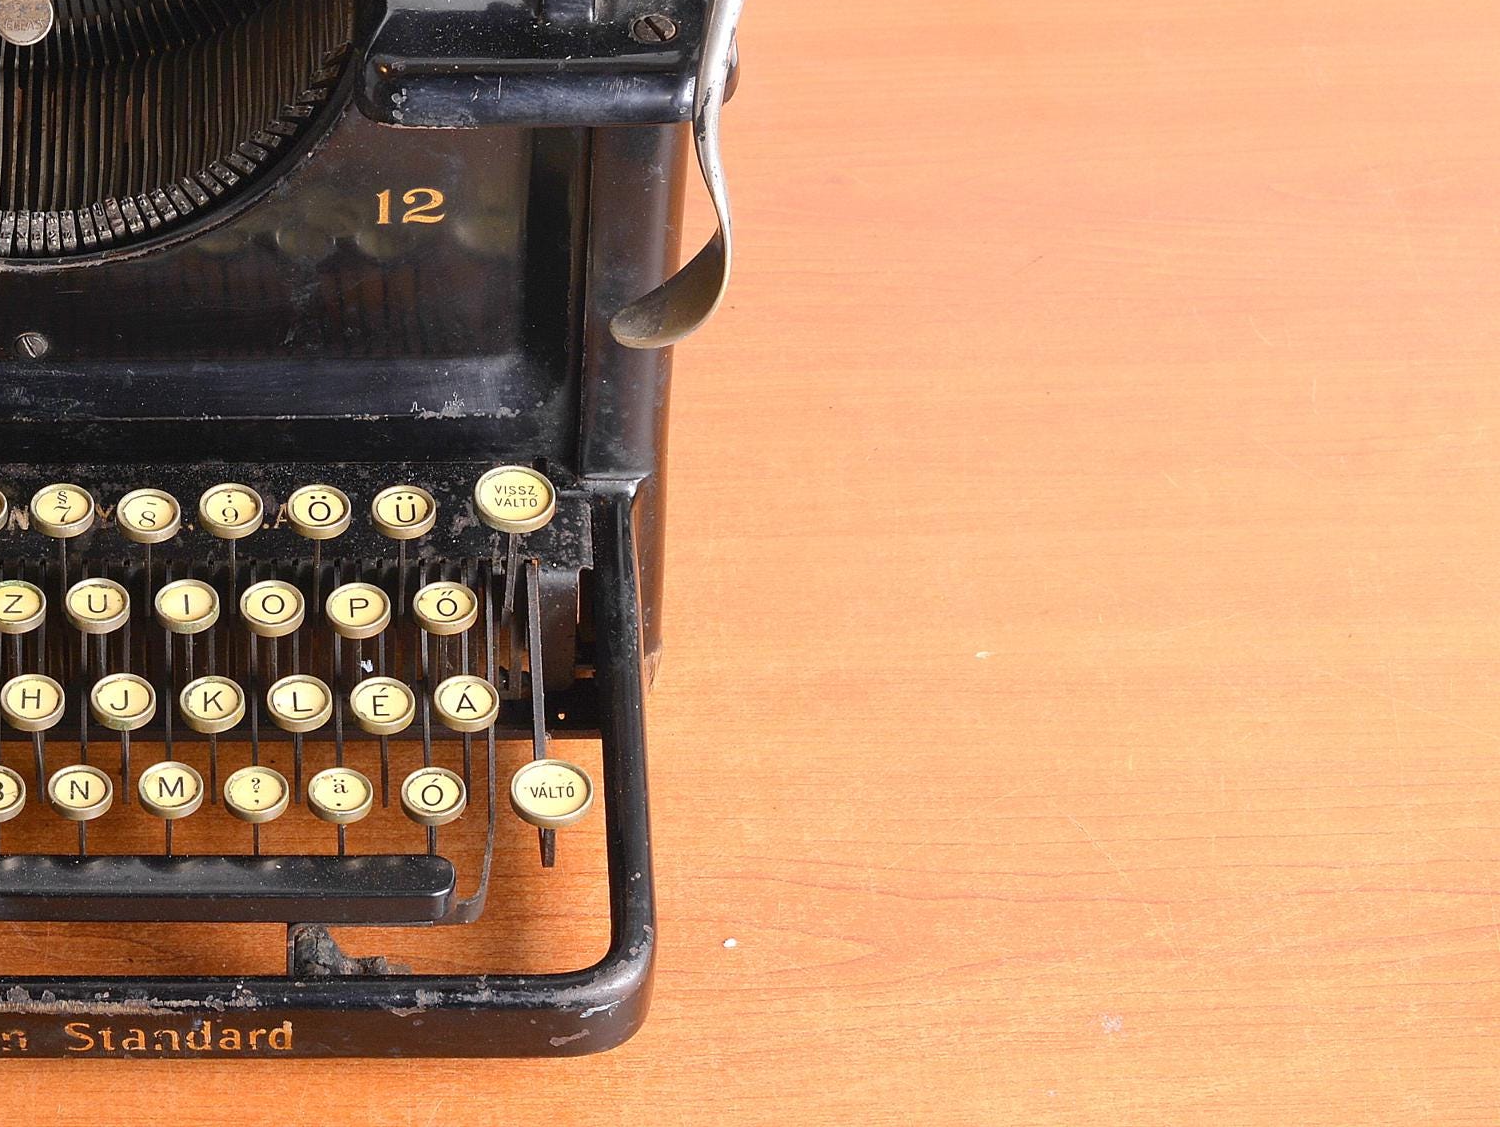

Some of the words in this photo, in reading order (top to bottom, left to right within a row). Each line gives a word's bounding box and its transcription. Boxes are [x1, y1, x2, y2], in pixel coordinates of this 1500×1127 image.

[376, 187, 445, 224] 12
[494, 485, 535, 495] VISSZ
[309, 494, 331, 522] Ö
[396, 494, 418, 523] Ü
[494, 494, 538, 507] VÁLTÓ
[54, 506, 73, 524] 7
[138, 510, 156, 528] 8
[221, 507, 239, 523] 9
[4, 595, 23, 613] Z
[88, 595, 107, 613] U
[185, 595, 189, 614] I
[262, 595, 284, 614] O
[350, 598, 368, 617] P
[22, 689, 40, 709] H
[110, 690, 128, 710] J
[204, 691, 223, 712] K
[293, 692, 313, 712] L
[373, 688, 389, 716] É
[456, 685, 477, 712] Á
[71, 781, 88, 799] N
[159, 777, 183, 797] M
[421, 778, 444, 806] Ó
[529, 782, 575, 799] VÁLTÓ
[63, 1019, 295, 1052] Standard
